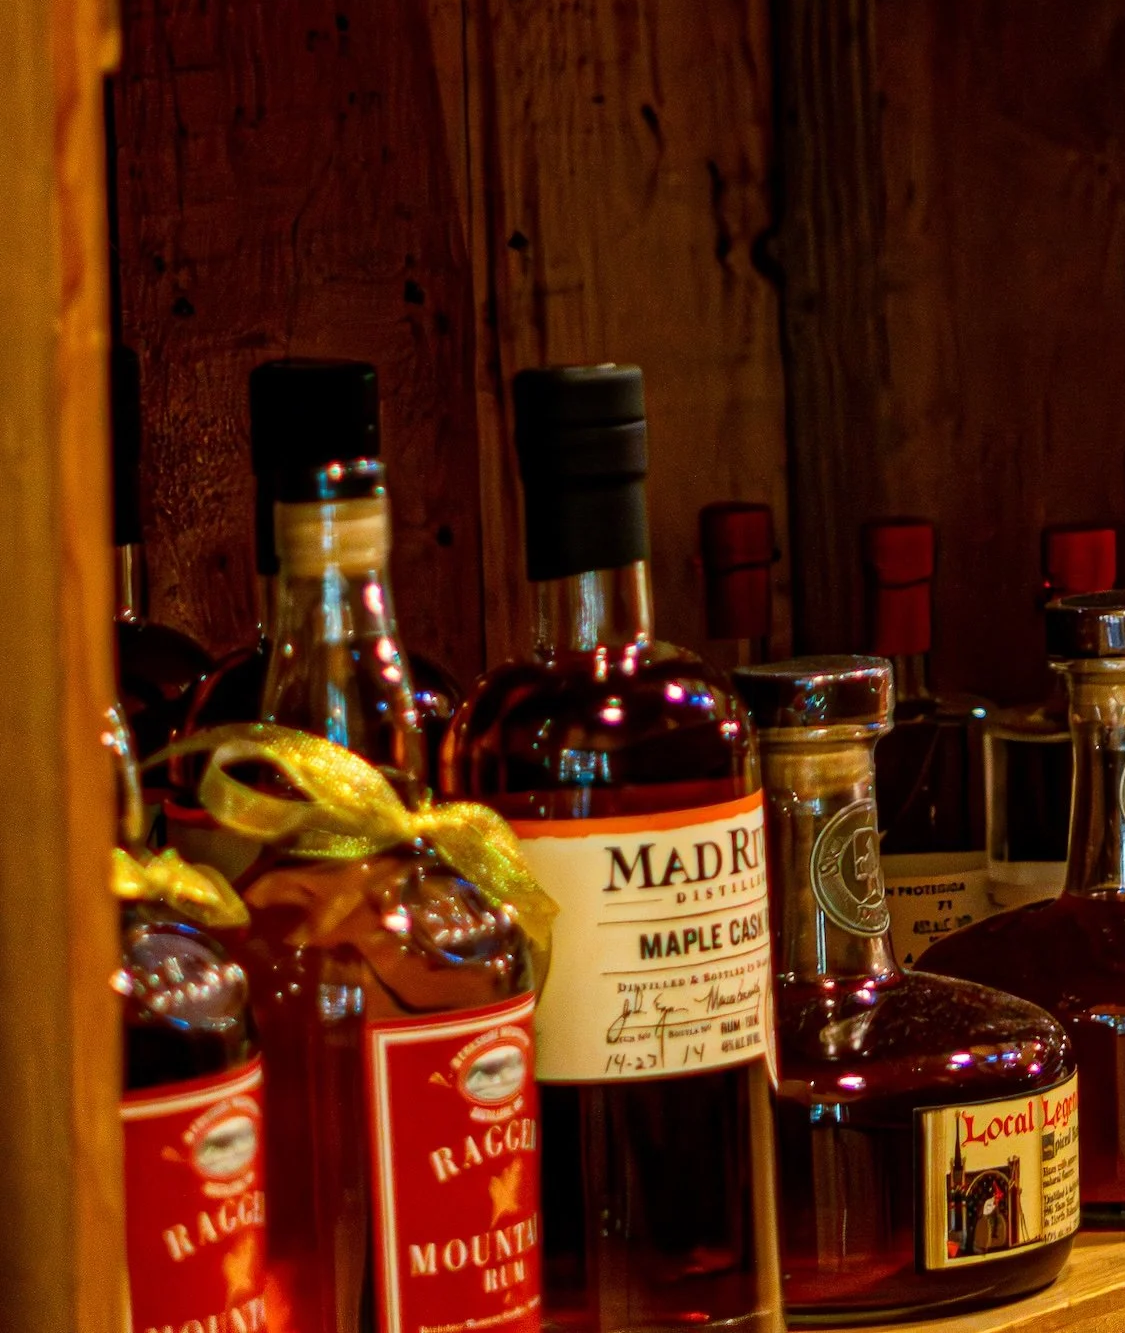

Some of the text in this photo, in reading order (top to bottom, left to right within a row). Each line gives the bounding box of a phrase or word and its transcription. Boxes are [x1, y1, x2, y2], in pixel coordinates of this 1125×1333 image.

[640, 922, 723, 960] MAPLE
[605, 1053, 657, 1075] 14-23
[683, 1042, 705, 1065] 14
[961, 1100, 1035, 1148] Local
[483, 1258, 527, 1294] RUM
